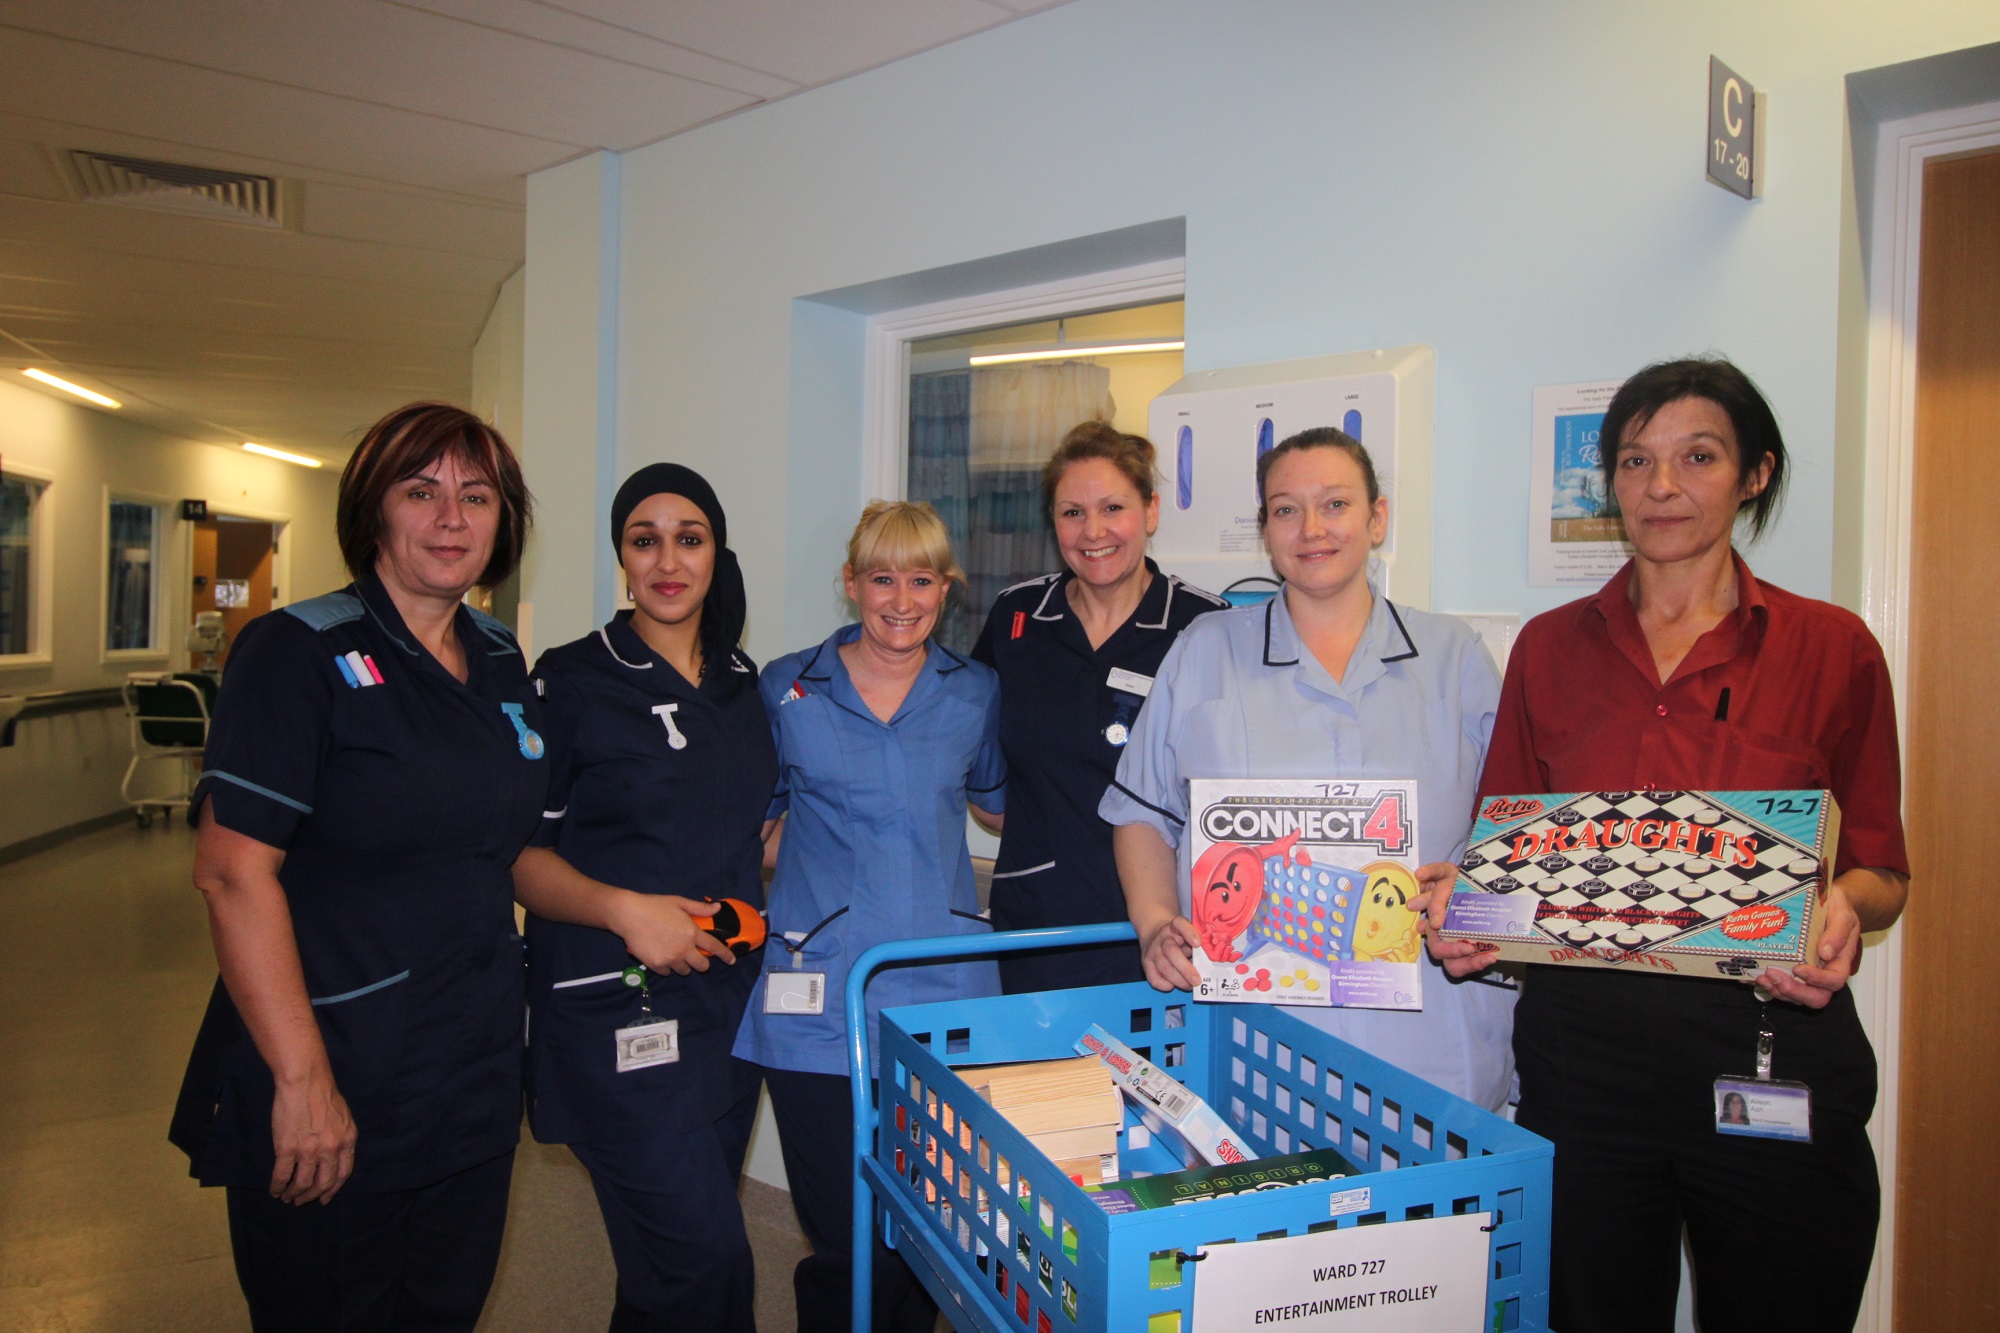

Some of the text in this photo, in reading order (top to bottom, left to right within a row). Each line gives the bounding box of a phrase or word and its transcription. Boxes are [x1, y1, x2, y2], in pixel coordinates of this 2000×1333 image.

[1723, 77, 1743, 138] C
[1714, 138, 1728, 164] 17
[1736, 152, 1749, 180] 20
[1314, 783, 1360, 797] 727
[1485, 799, 1540, 814] Retro
[1756, 798, 1820, 816] 727
[1206, 797, 1404, 849] CONNECT 4
[1506, 819, 1759, 869] DRAUGHTS
[1602, 916, 1660, 925] INSTRUCTION
[1654, 910, 1701, 918] DRAUGHTS
[1726, 909, 1781, 923] Retro Games
[1724, 916, 1784, 934] Family Fun!
[1757, 943, 1795, 951] PLAYERS
[1788, 935, 1796, 943] 2
[1549, 948, 1677, 971] DRAUGHTS
[1200, 983, 1214, 996] 6+
[1313, 1259, 1386, 1282] WARD 727
[1255, 1284, 1438, 1325] ENTERTAINMENT TROLLEY
